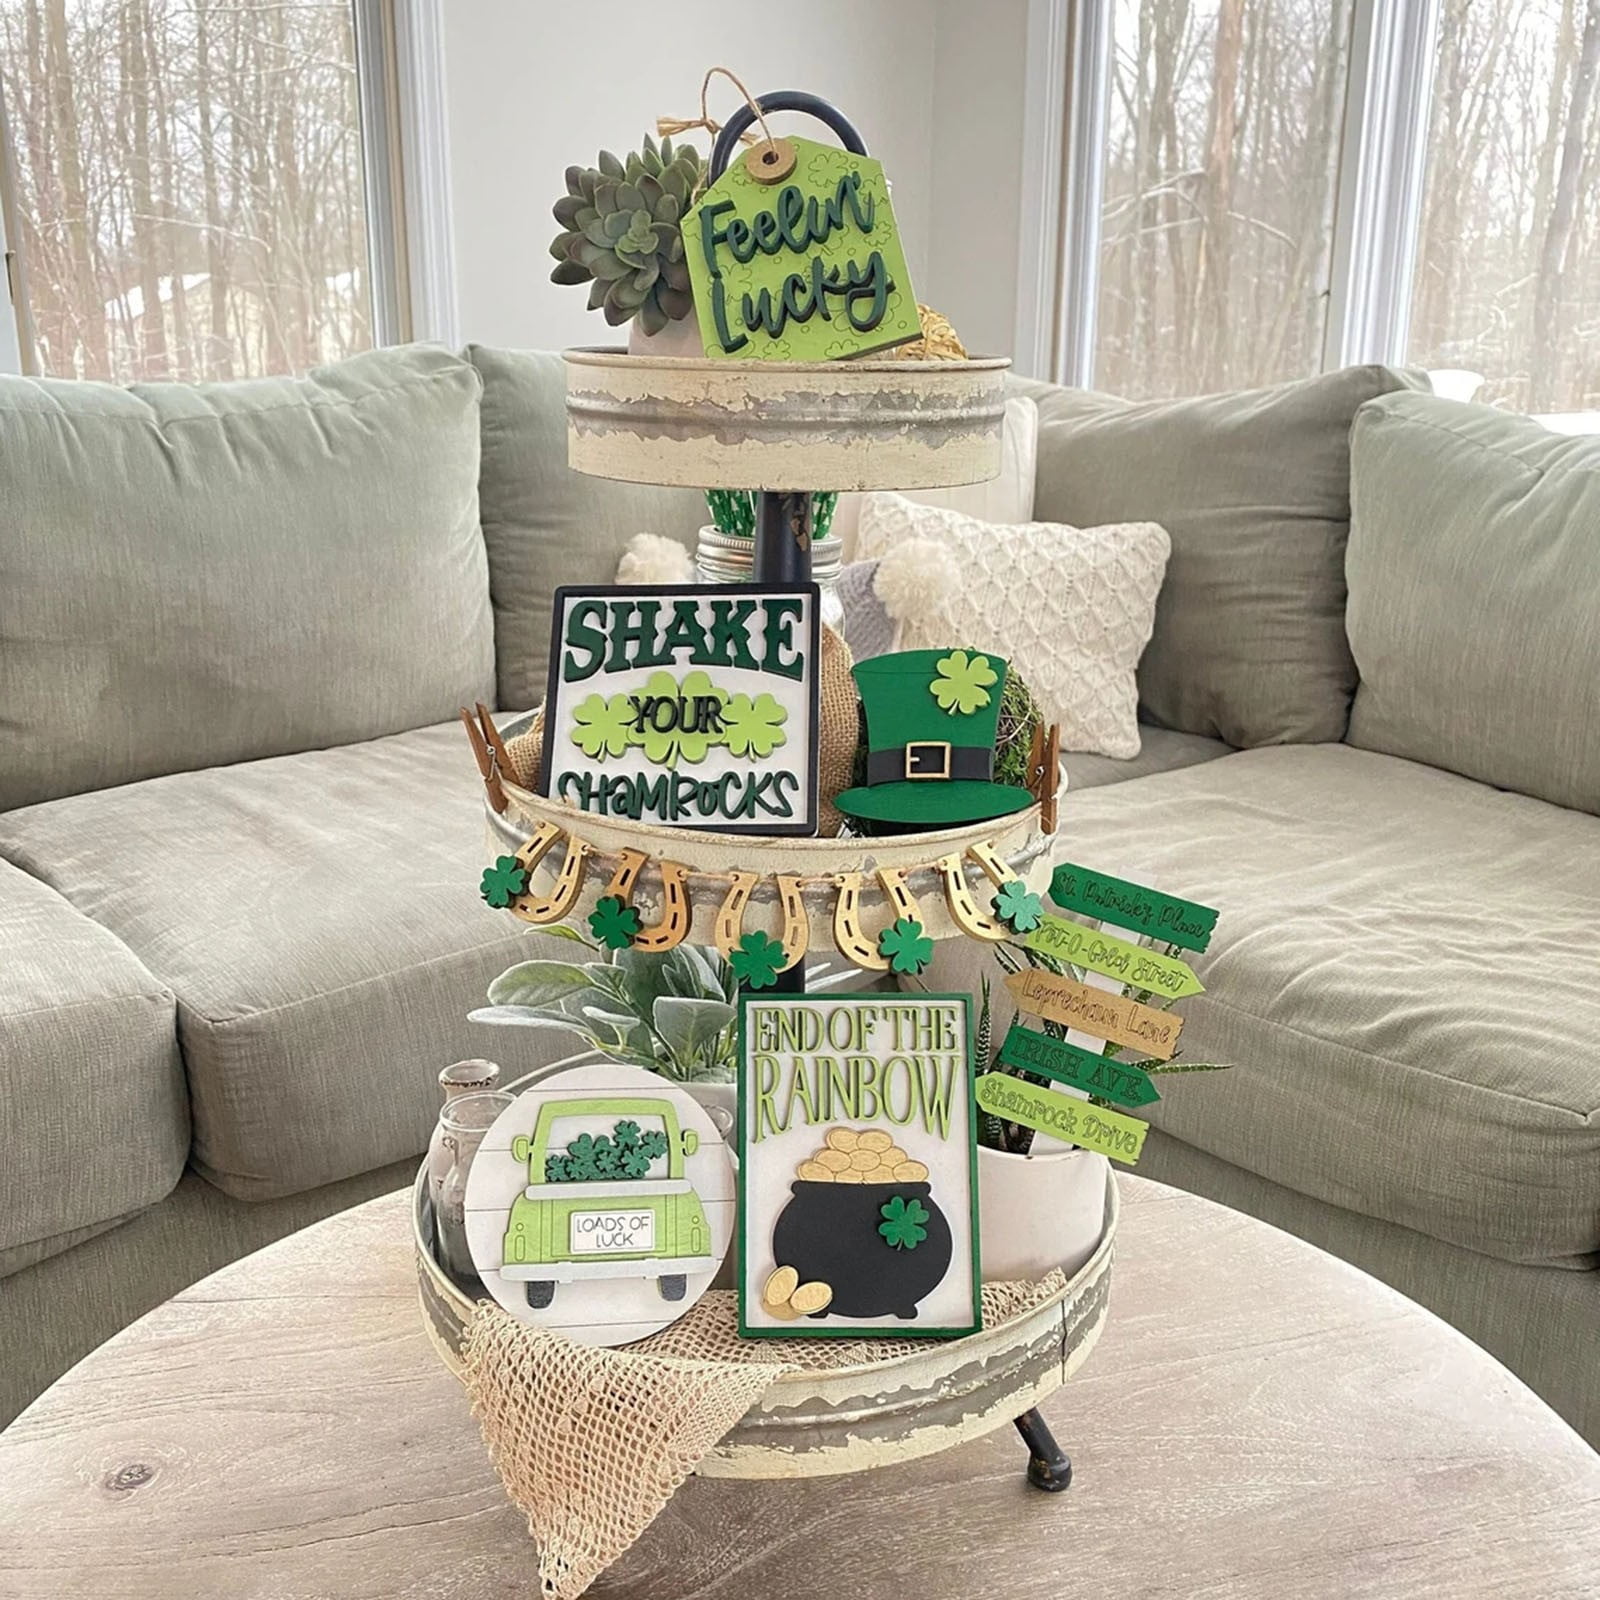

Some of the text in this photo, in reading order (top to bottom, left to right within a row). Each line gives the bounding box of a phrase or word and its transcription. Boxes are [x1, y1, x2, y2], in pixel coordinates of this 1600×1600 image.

[711, 251, 896, 354] Lucky
[564, 599, 804, 683] SHAKE
[627, 696, 724, 734] YOUR
[1157, 902, 1206, 938] Place
[1131, 957, 1189, 992] Street
[752, 1005, 961, 1052] END OF THE
[1021, 969, 1171, 1044] Leprechaun Lane
[1010, 1035, 1143, 1101] IRISH AVE
[751, 1055, 963, 1144] RAINBOW
[979, 1077, 1139, 1155] Shamrock Drive
[576, 1215, 651, 1234] LOADS OF
[596, 1231, 635, 1249] LUCK
